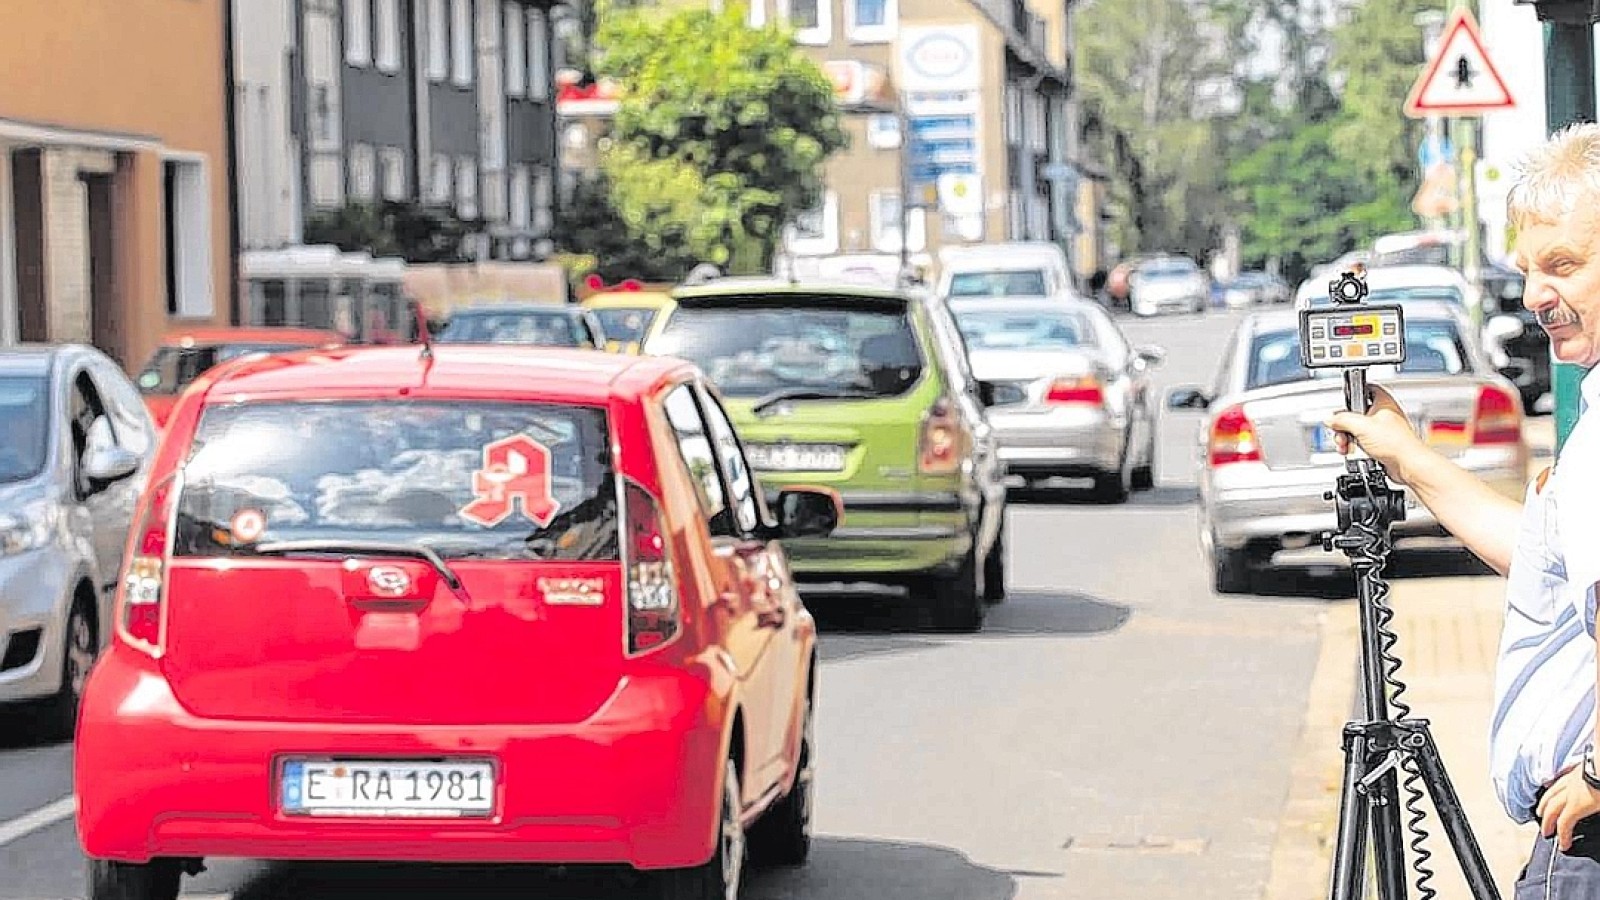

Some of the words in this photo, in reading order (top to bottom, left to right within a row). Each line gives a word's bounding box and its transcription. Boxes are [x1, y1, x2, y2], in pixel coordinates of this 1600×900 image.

[307, 769, 326, 800] E
[352, 769, 393, 801] RA
[404, 769, 487, 802] 1981
